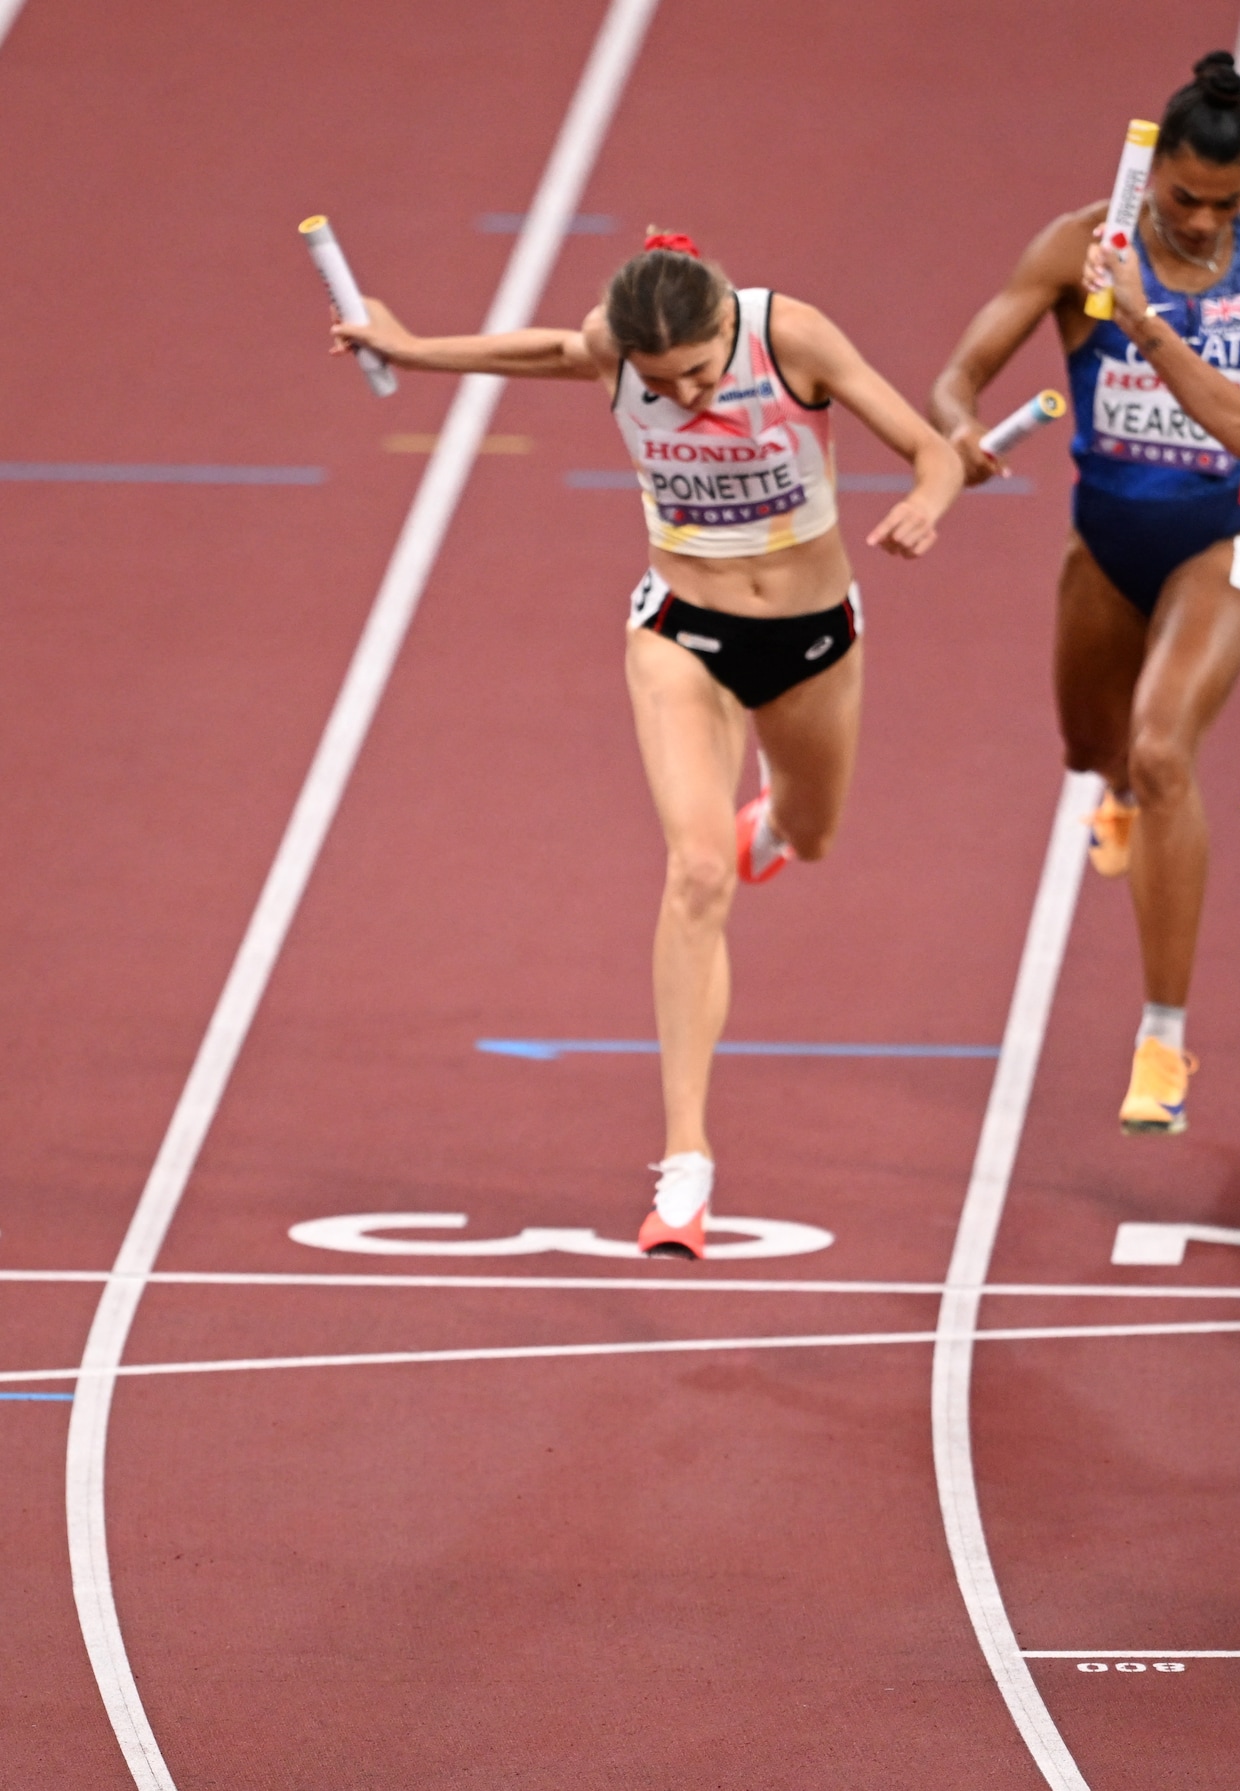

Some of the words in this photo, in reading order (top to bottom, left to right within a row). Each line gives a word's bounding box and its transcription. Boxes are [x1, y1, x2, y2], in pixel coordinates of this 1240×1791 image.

[643, 440, 785, 464] HONDA
[652, 464, 792, 501] PONETTE
[1076, 1662, 1186, 1673] 800
